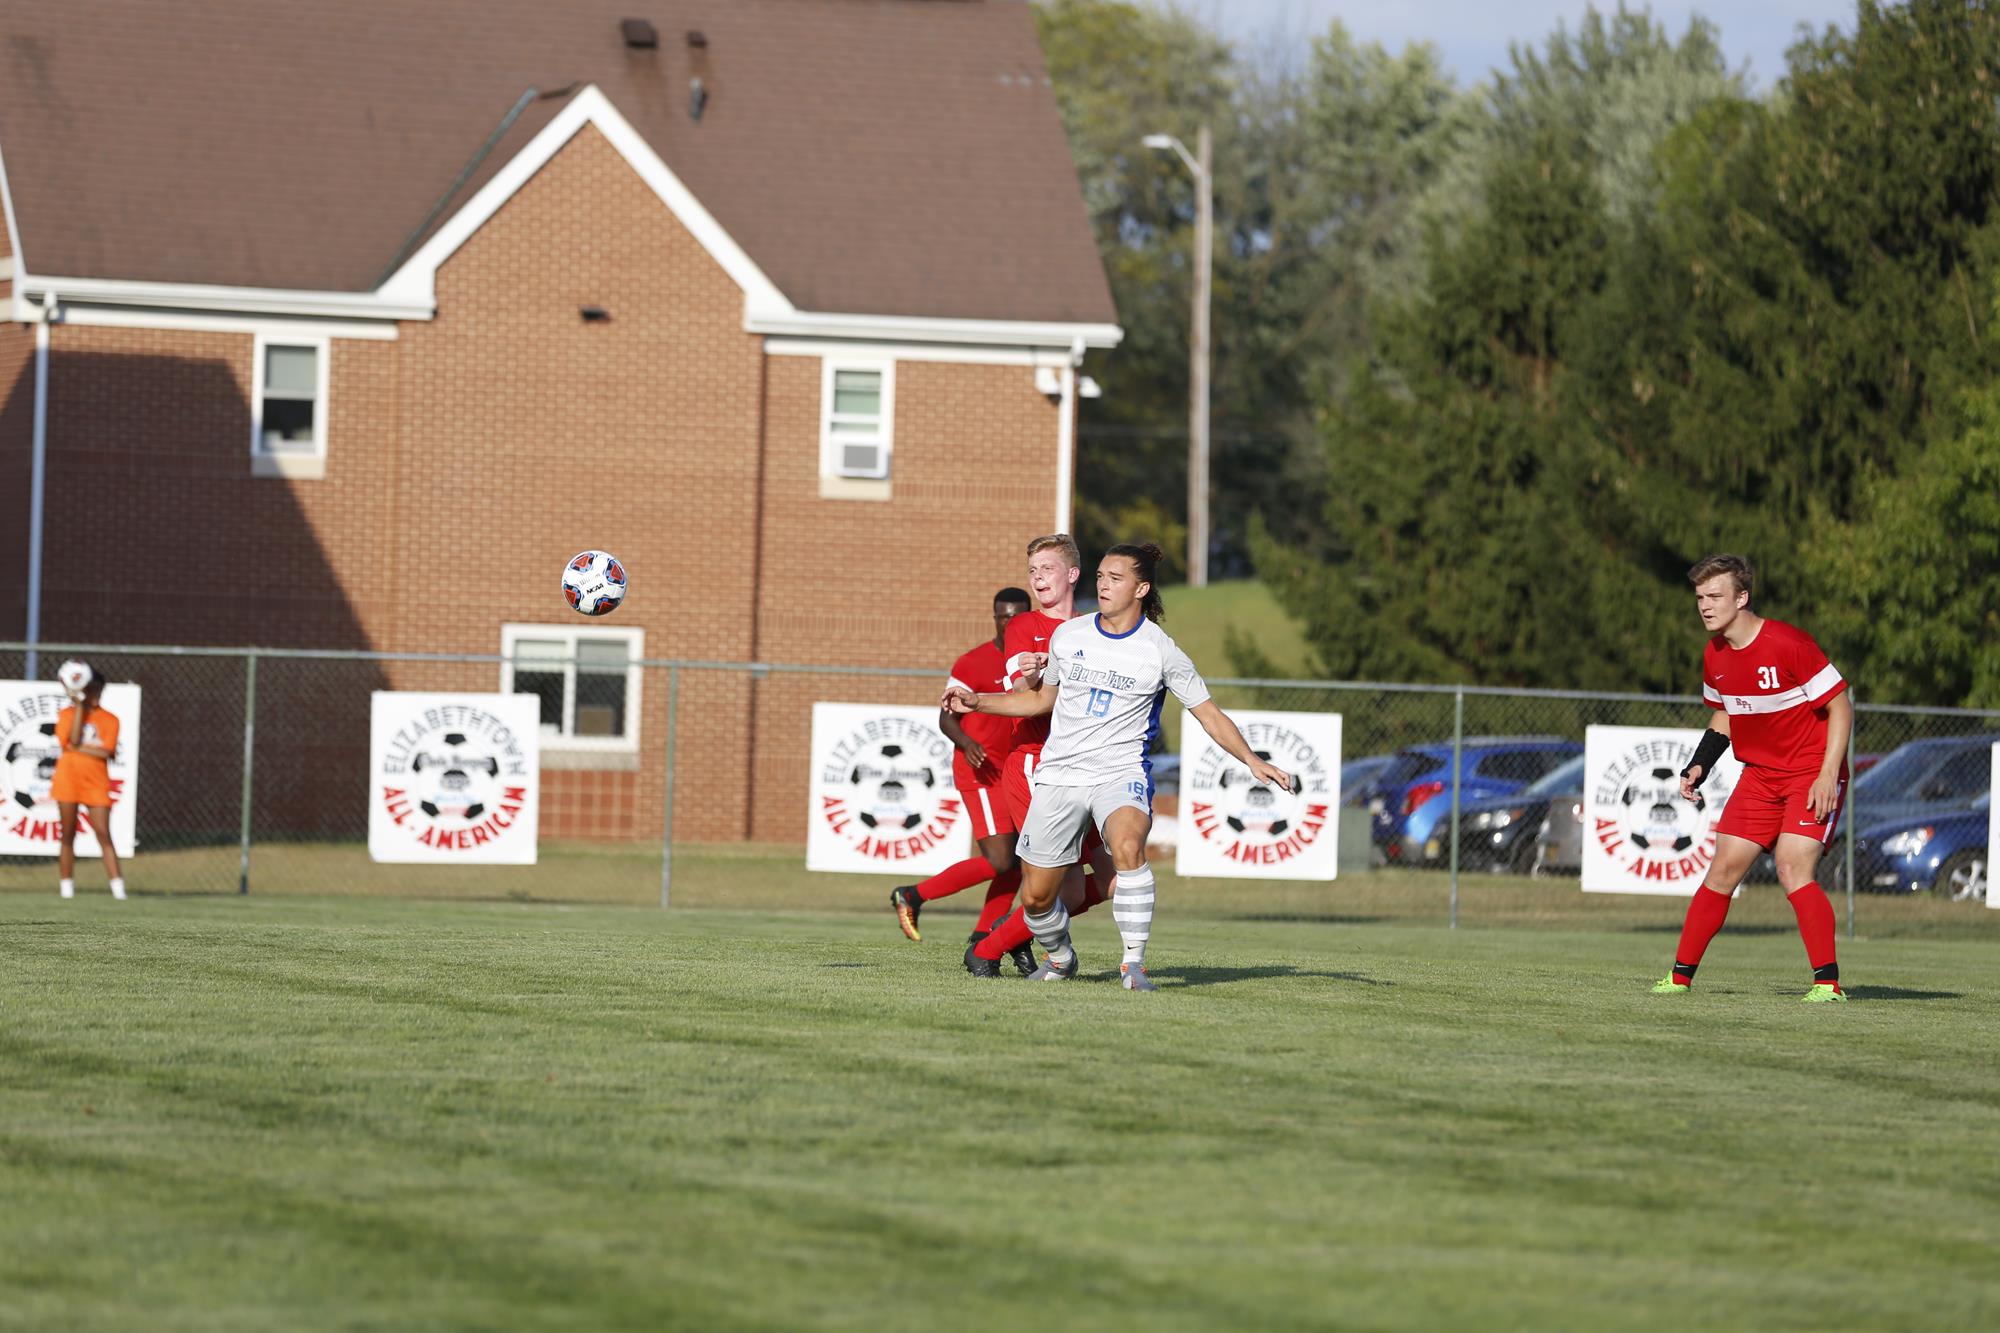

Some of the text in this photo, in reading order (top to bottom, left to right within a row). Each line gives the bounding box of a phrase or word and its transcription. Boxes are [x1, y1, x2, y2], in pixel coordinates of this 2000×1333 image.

[586, 583, 604, 594] NCAA
[1757, 666, 1780, 689] 31
[1127, 781, 1144, 796] 18
